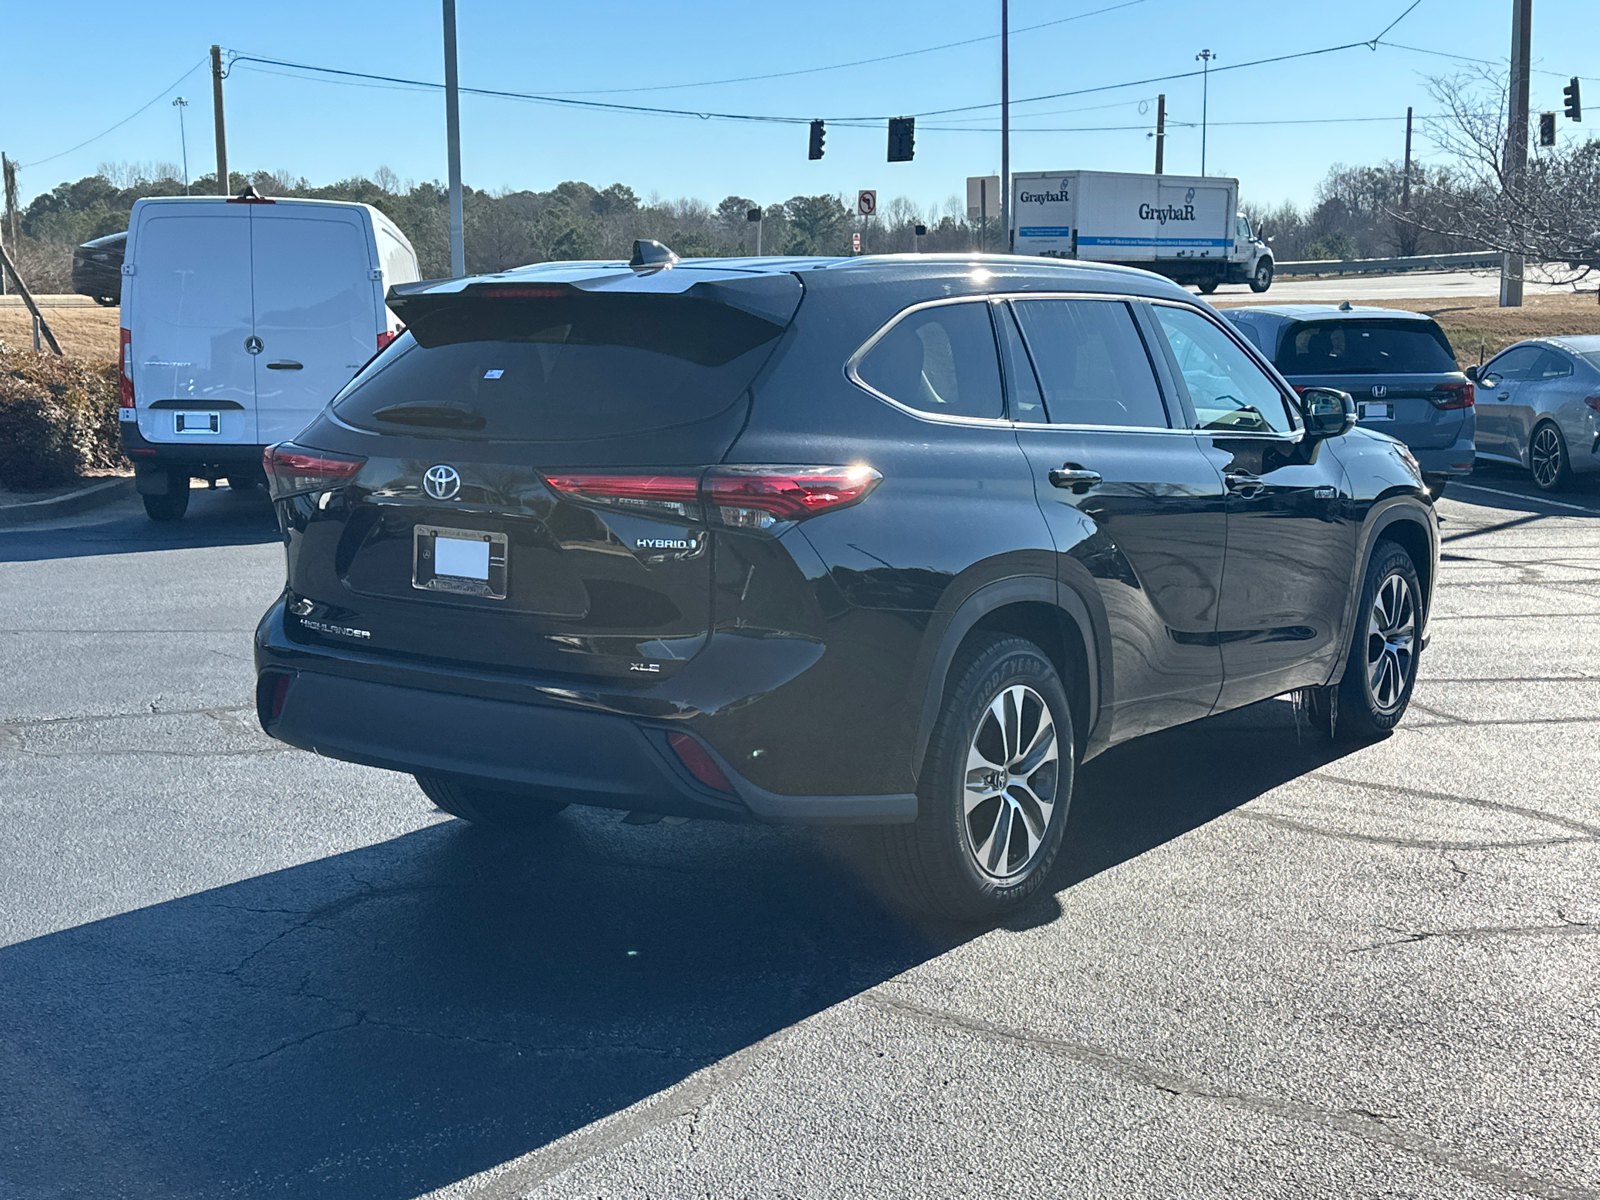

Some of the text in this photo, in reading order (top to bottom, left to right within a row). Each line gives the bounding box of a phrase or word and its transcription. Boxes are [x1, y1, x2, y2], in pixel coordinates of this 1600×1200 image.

[1020, 190, 1070, 206] GraybaR
[1138, 202, 1196, 226] GraybaR
[636, 538, 687, 549] HYBRID
[299, 618, 371, 640] HIGHLANDER
[630, 662, 660, 673] XLE
